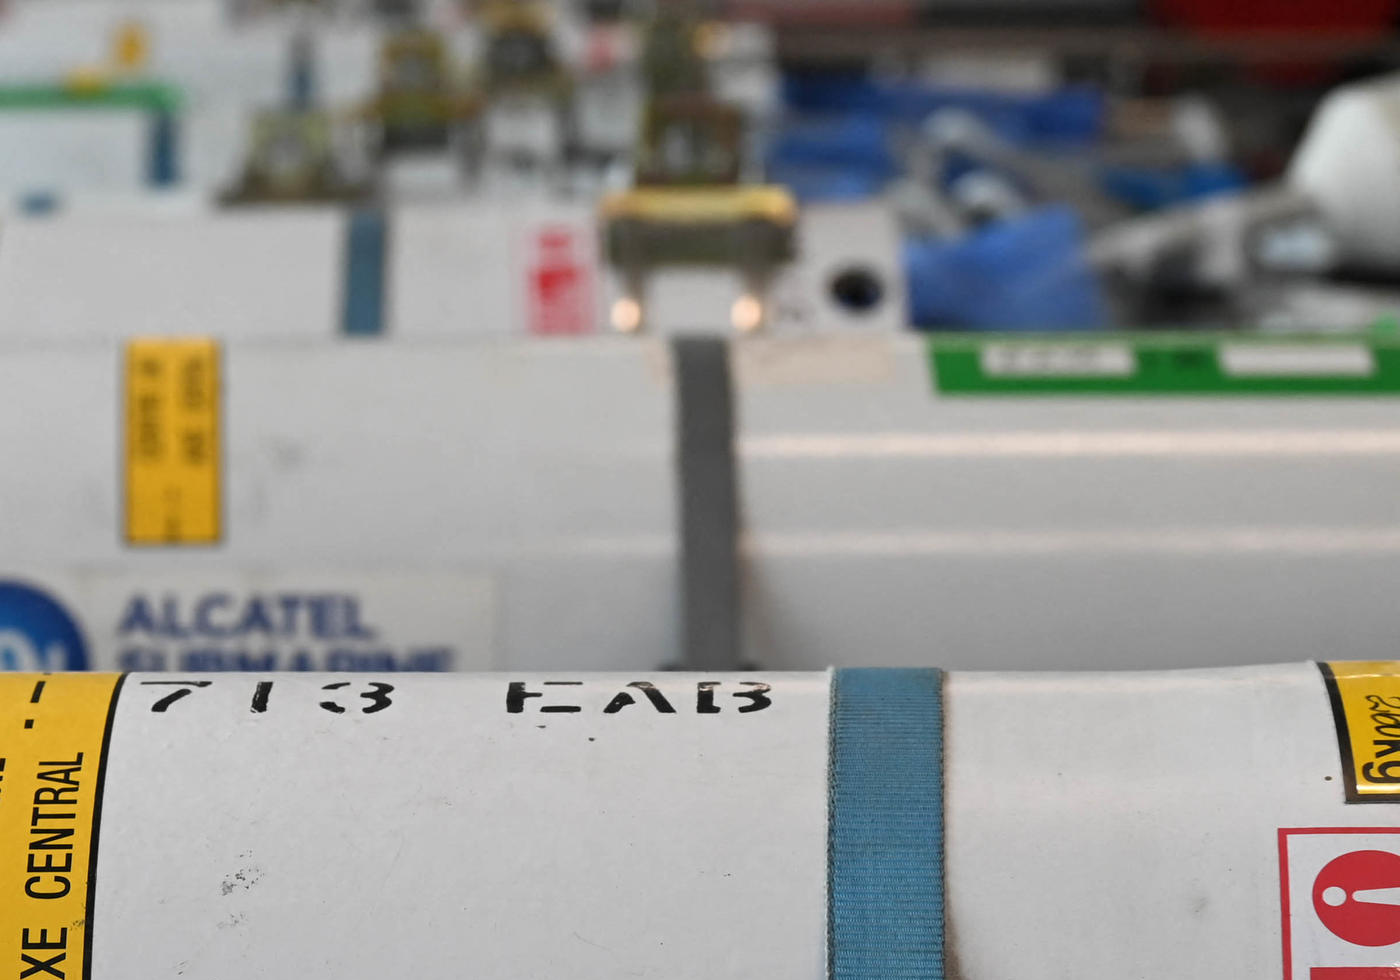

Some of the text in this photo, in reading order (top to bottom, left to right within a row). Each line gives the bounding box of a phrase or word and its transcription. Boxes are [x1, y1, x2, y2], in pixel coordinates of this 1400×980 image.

[116, 594, 376, 640] ALCATEL
[505, 681, 773, 714] EAB
[24, 751, 84, 900] CENTRAL
